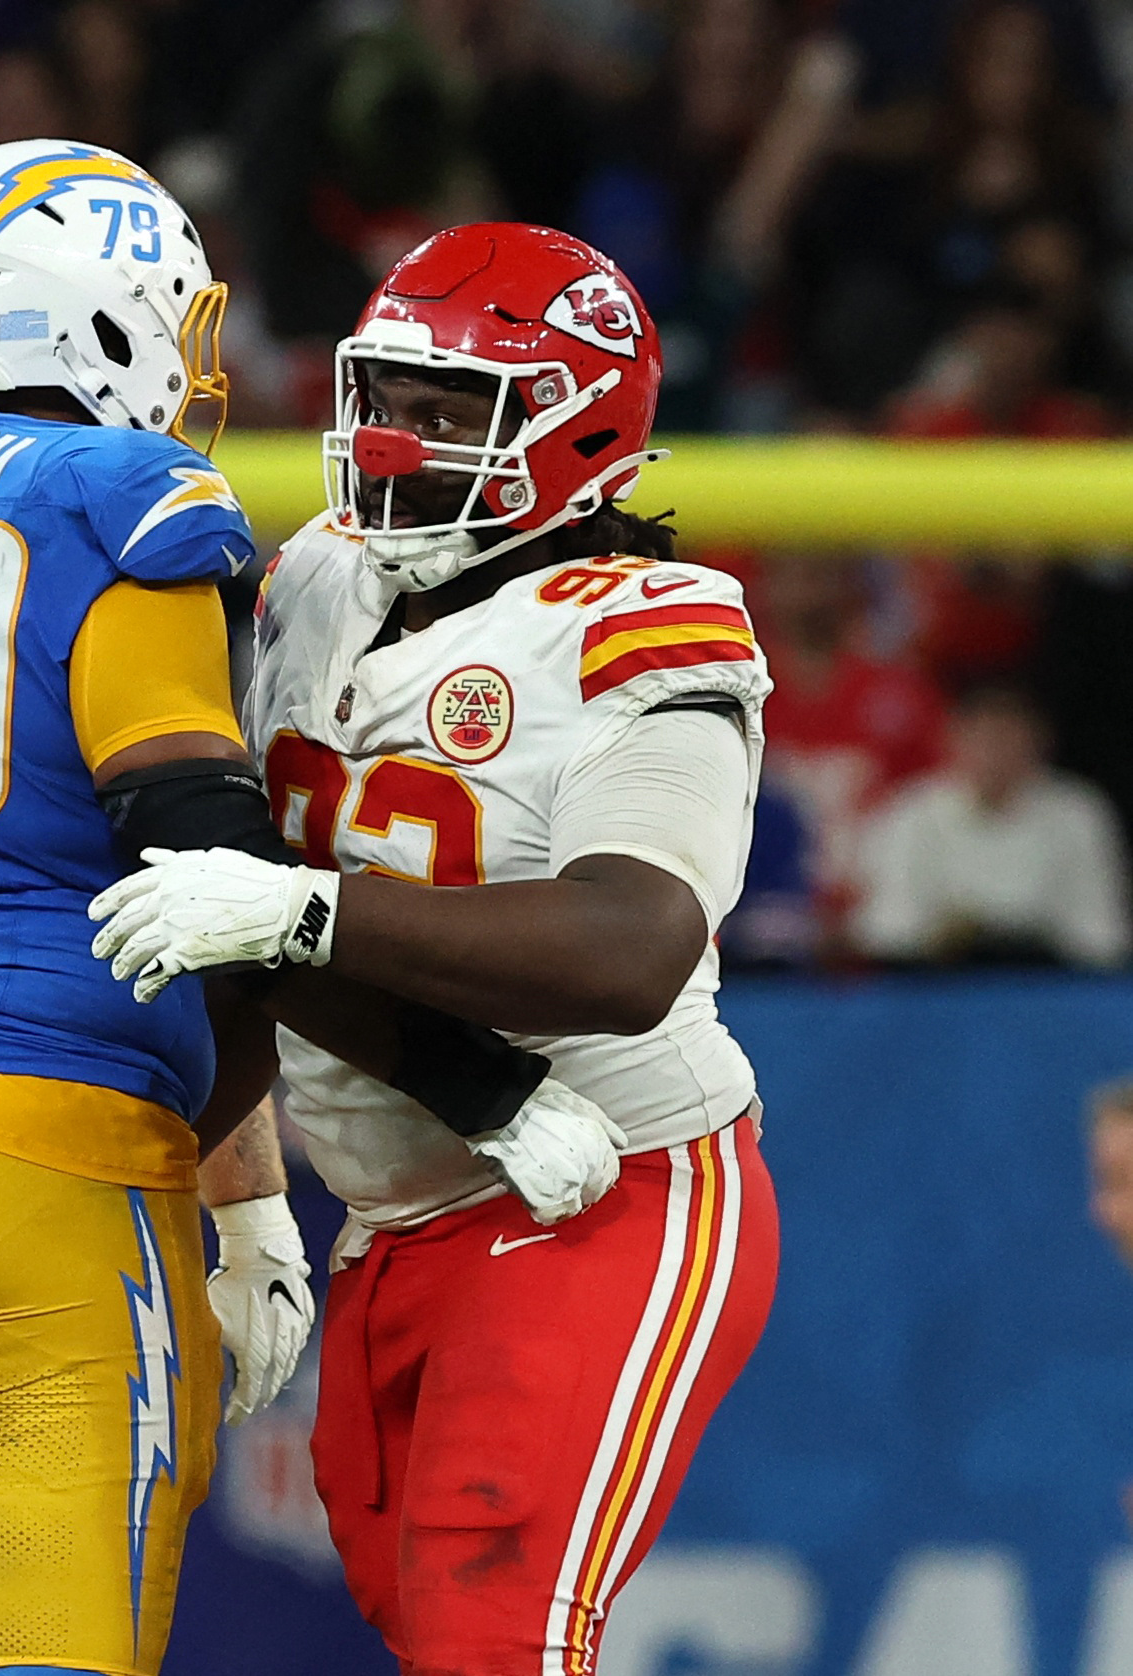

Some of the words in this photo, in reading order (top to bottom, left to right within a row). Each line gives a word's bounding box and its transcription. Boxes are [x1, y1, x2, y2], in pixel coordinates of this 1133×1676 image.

[88, 199, 161, 263] 79
[564, 287, 634, 339] KC
[293, 891, 330, 953] NIKE
